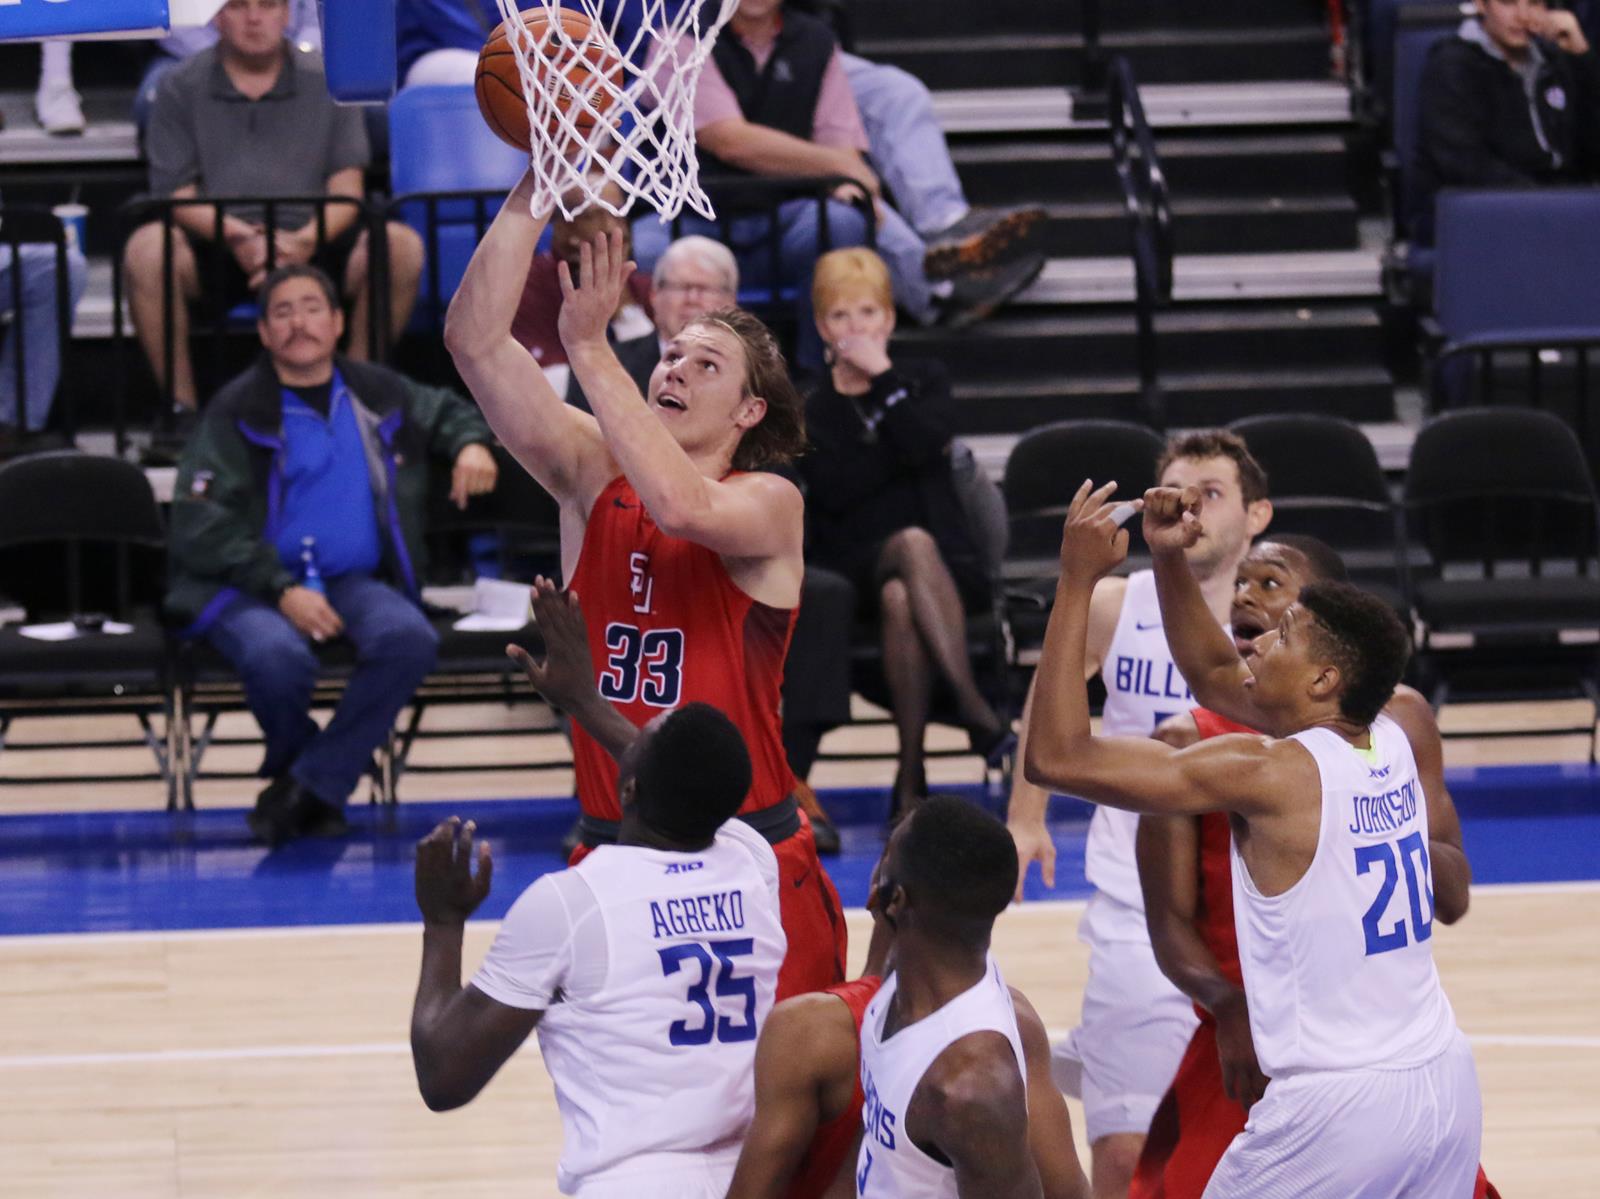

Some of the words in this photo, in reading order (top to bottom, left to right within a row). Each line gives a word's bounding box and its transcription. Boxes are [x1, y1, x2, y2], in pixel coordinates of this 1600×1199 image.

[599, 621, 684, 708] 33
[1349, 778, 1417, 834] JOHNSON
[650, 889, 744, 938] AGBEKO
[1353, 830, 1435, 956] 20
[656, 937, 757, 1046] 35
